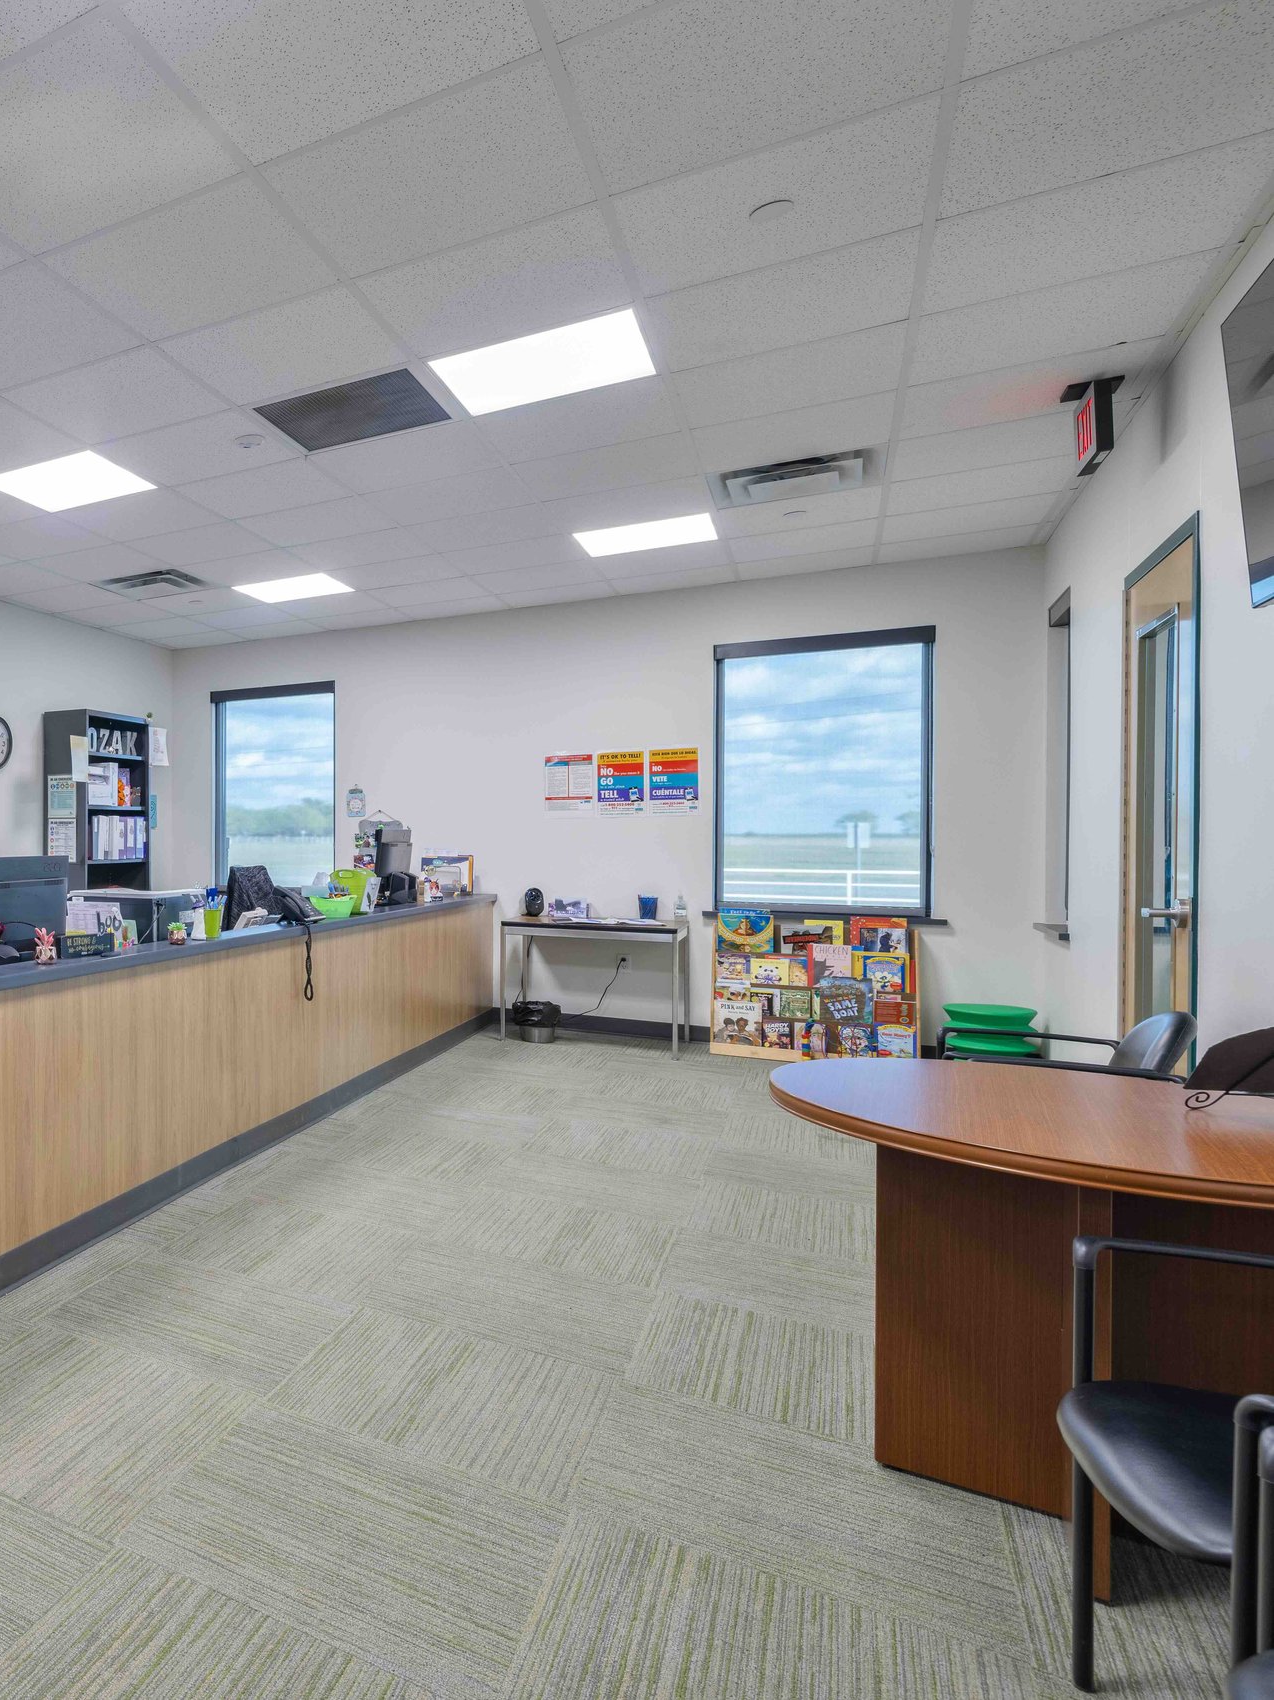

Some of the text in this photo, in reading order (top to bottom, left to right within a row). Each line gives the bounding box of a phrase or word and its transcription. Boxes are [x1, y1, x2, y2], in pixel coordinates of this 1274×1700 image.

[1077, 396, 1093, 461] EXIT
[96, 911, 122, 934] boo
[73, 937, 91, 946] STRONG
[815, 945, 848, 955] CHICKEN
[827, 999, 858, 1011] SAME
[833, 1008, 858, 1020] BOAT
